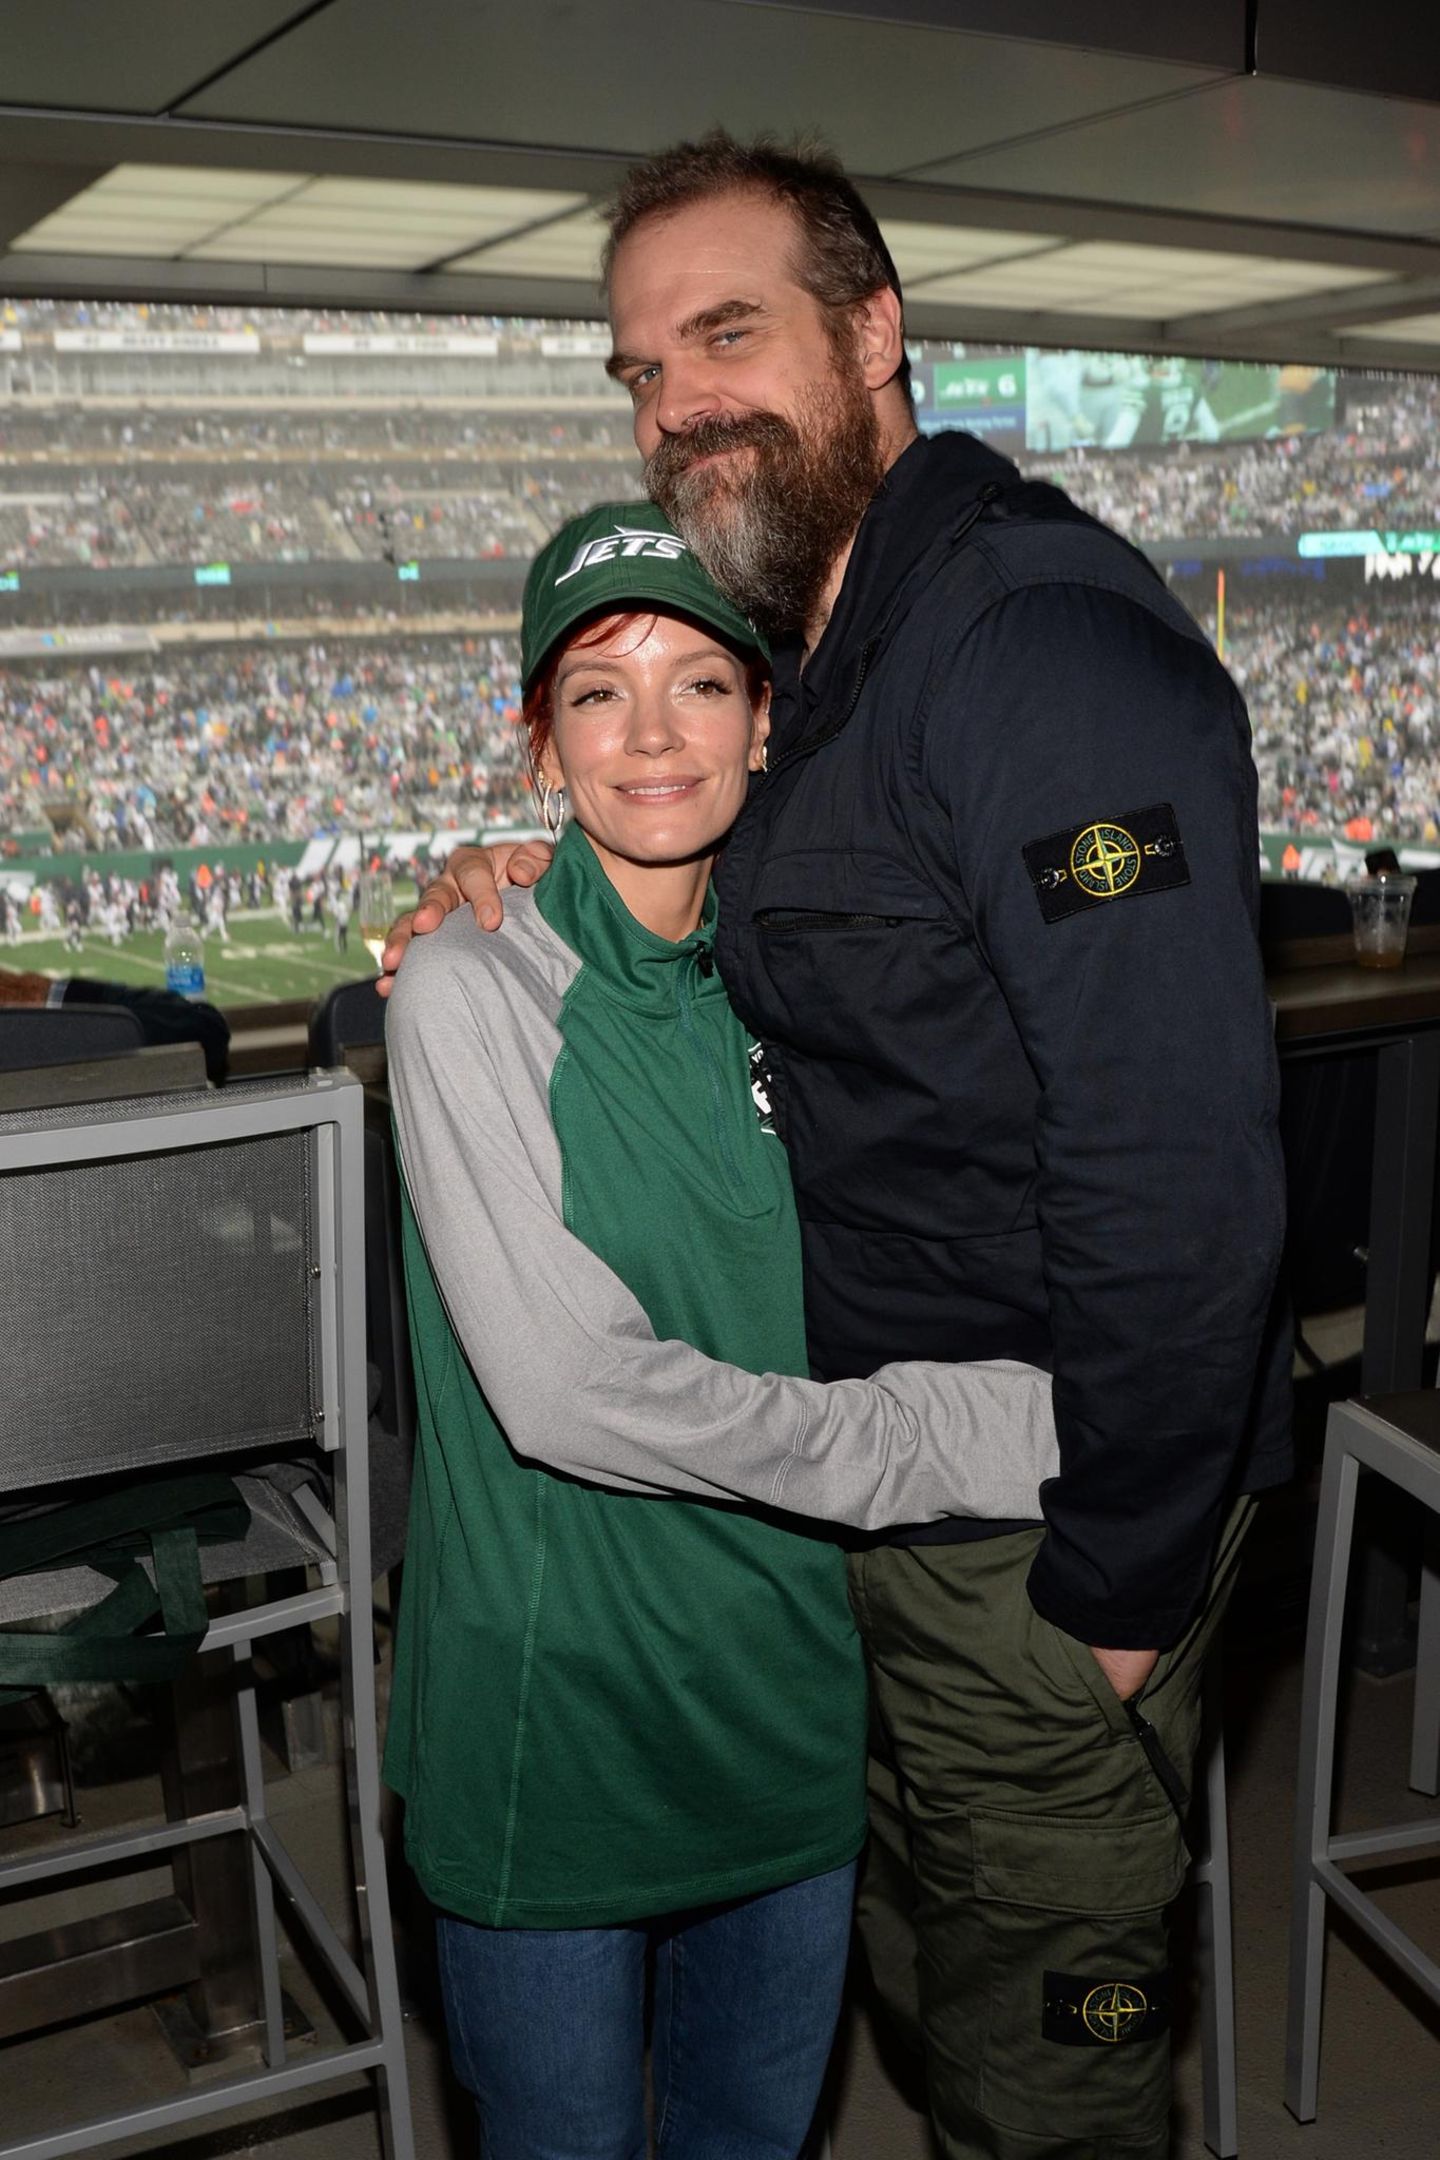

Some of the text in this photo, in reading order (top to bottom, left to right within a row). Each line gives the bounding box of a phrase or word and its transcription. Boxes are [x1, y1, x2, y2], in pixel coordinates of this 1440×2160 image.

[554, 525, 687, 588] JETS
[1075, 828, 1133, 865] STONE ISLAND
[1079, 858, 1137, 892] STONE ISLAND
